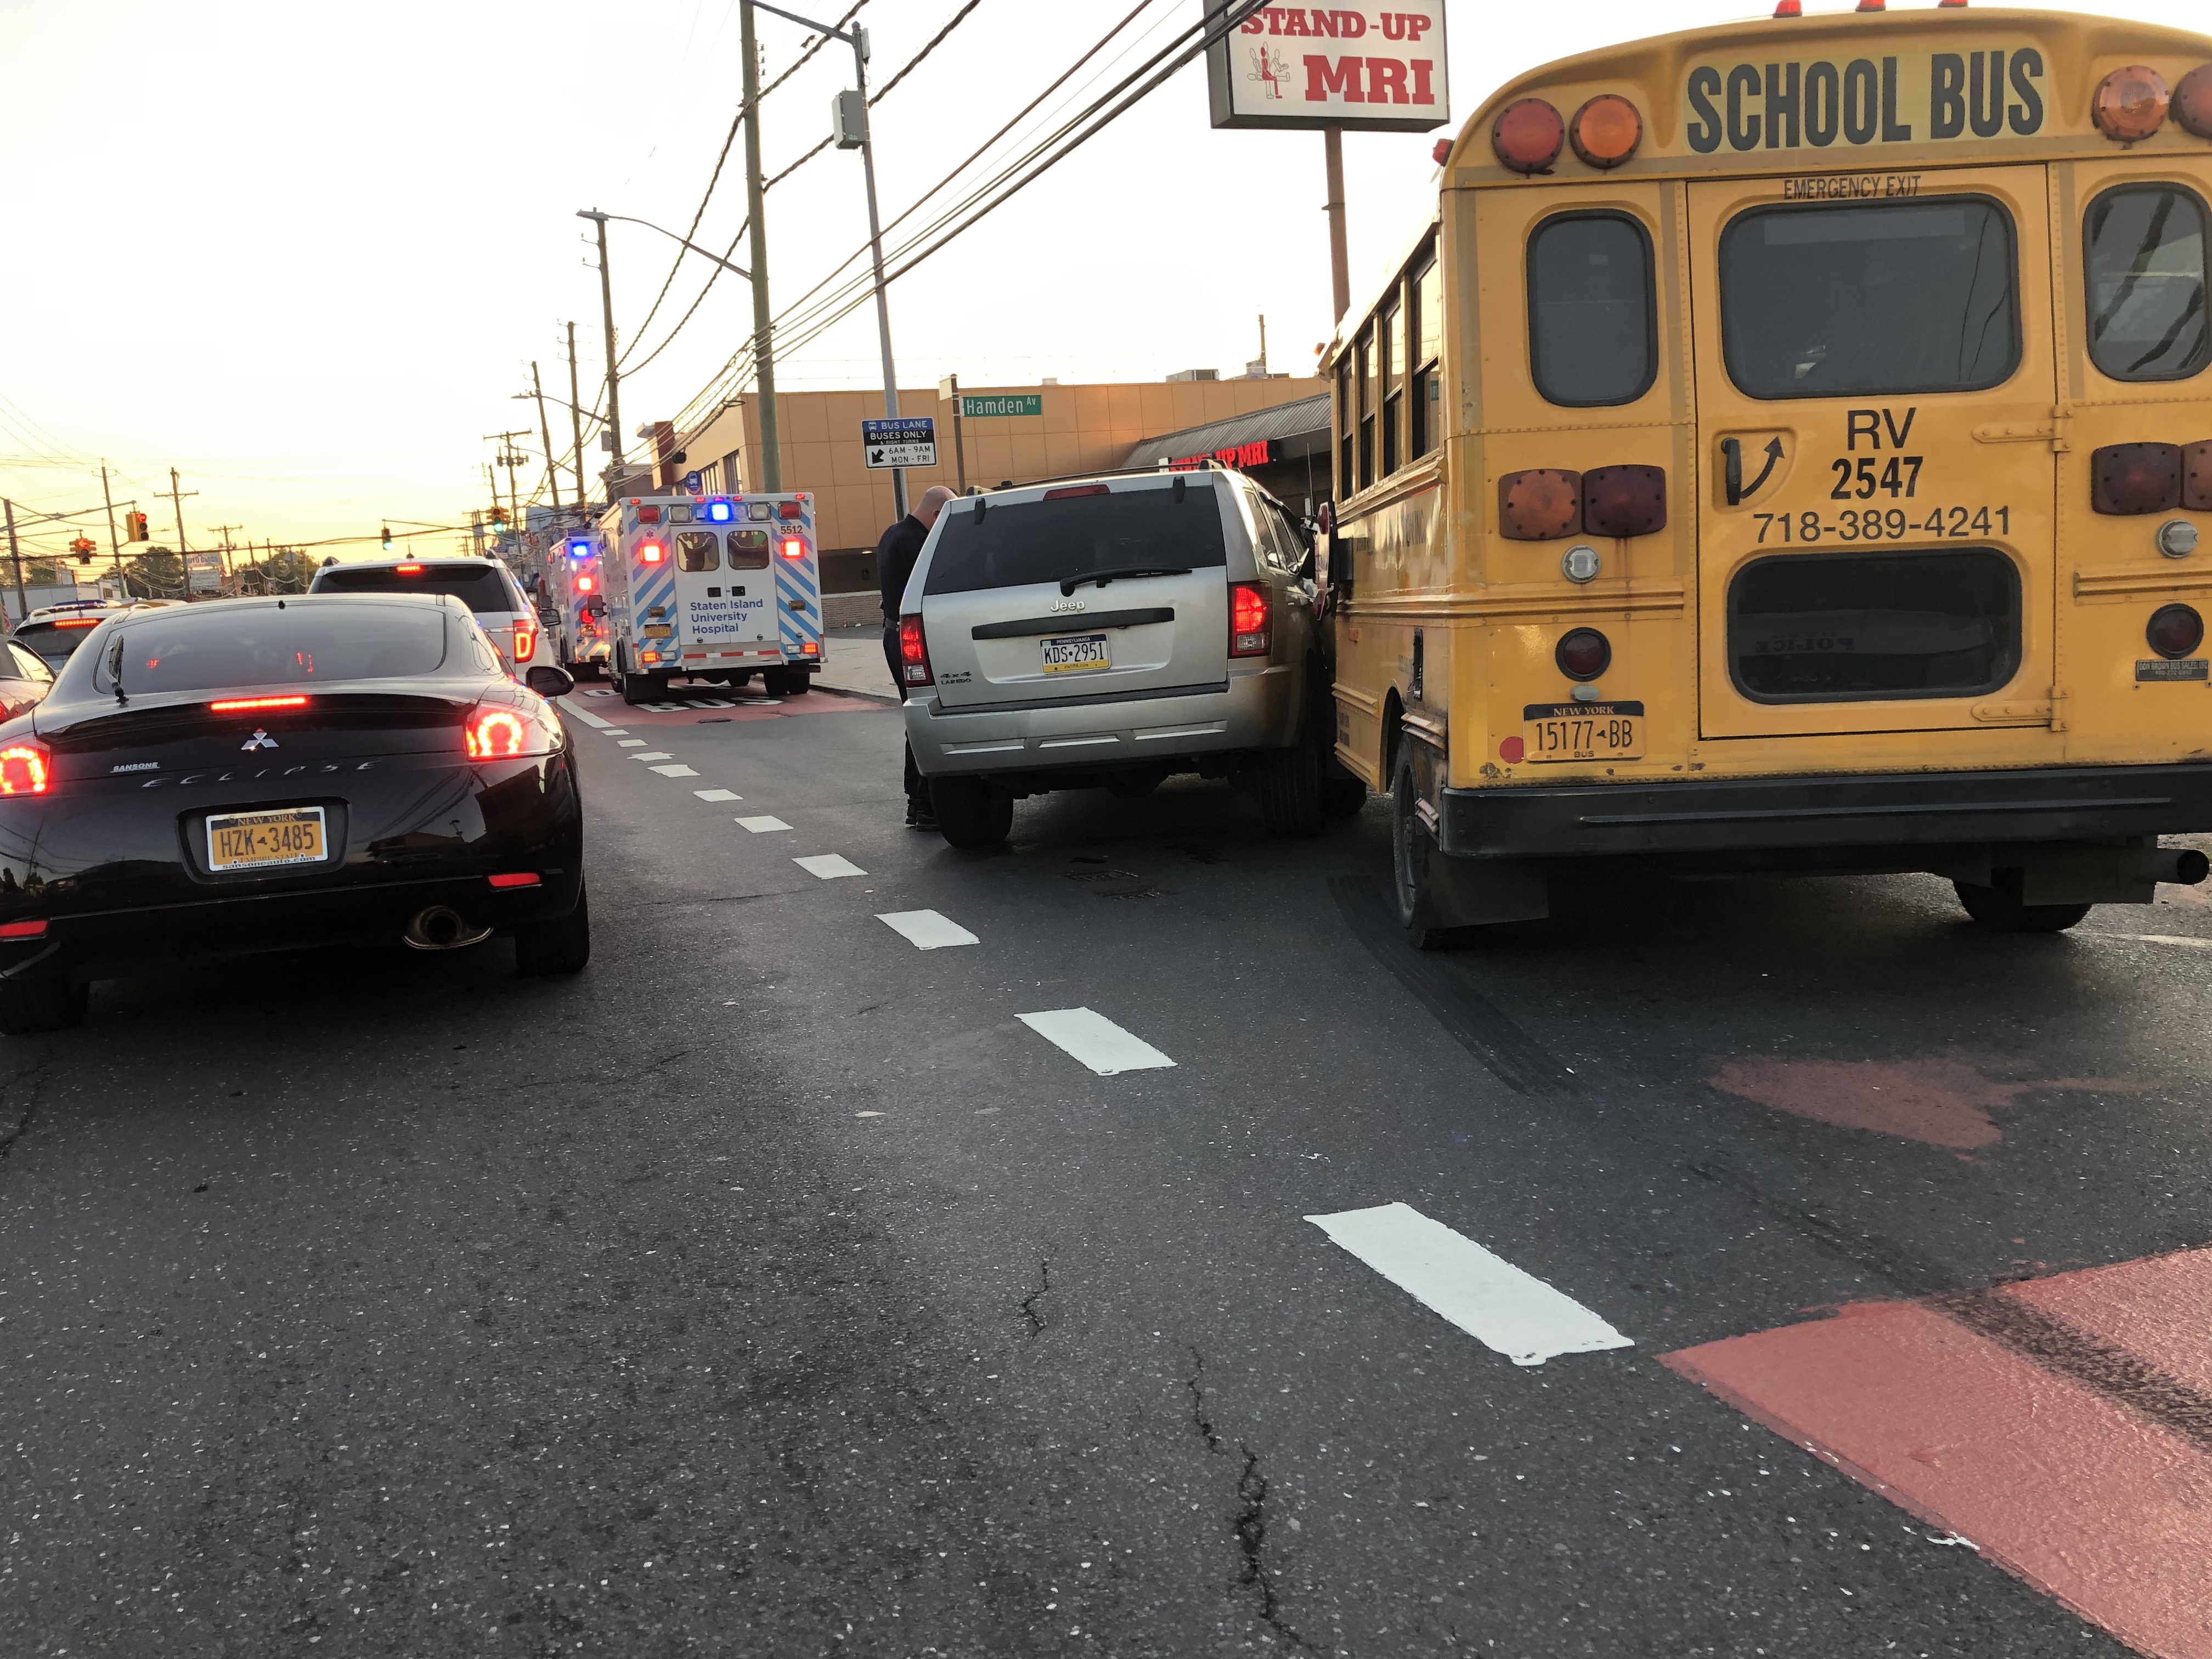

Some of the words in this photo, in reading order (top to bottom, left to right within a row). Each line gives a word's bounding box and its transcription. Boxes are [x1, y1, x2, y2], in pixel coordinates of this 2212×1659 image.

[1241, 7, 1431, 41] STAND-UP
[1303, 54, 1435, 105] MRI
[1687, 56, 1911, 153] SCHOOL
[1931, 47, 2044, 140] BUS
[1784, 176, 1881, 200] EMERGENCY
[1886, 175, 1921, 196] EXIT
[966, 397, 1024, 415] Hamden
[1026, 396, 1036, 405] Av
[870, 431, 901, 440] BUSES
[903, 430, 927, 438] ONLY
[881, 421, 900, 430] BUS
[902, 420, 928, 429] LANE
[1847, 407, 1916, 450] RV
[1237, 440, 1268, 469] MRI
[1830, 456, 1923, 500] 2547
[781, 525, 803, 534] 5512
[1753, 505, 2010, 544] 718-389-4241
[690, 602, 726, 611] Staten
[730, 599, 763, 609] Island
[1050, 600, 1085, 612] Jeep
[691, 612, 747, 622] University
[692, 623, 738, 635] Hospital
[1044, 646, 1068, 664] KDS
[1074, 642, 1104, 662] 2951
[1585, 706, 1614, 714] YORK
[1536, 721, 1593, 751] 15177
[1610, 720, 1633, 748] BB
[113, 762, 159, 772] SANSONE
[142, 760, 382, 788] ECLIPSE
[237, 817, 263, 826] NEW
[268, 814, 296, 823] YORK
[221, 829, 256, 857] HZK
[268, 823, 314, 853] 3485
[222, 856, 315, 870] sansoneauto.com
